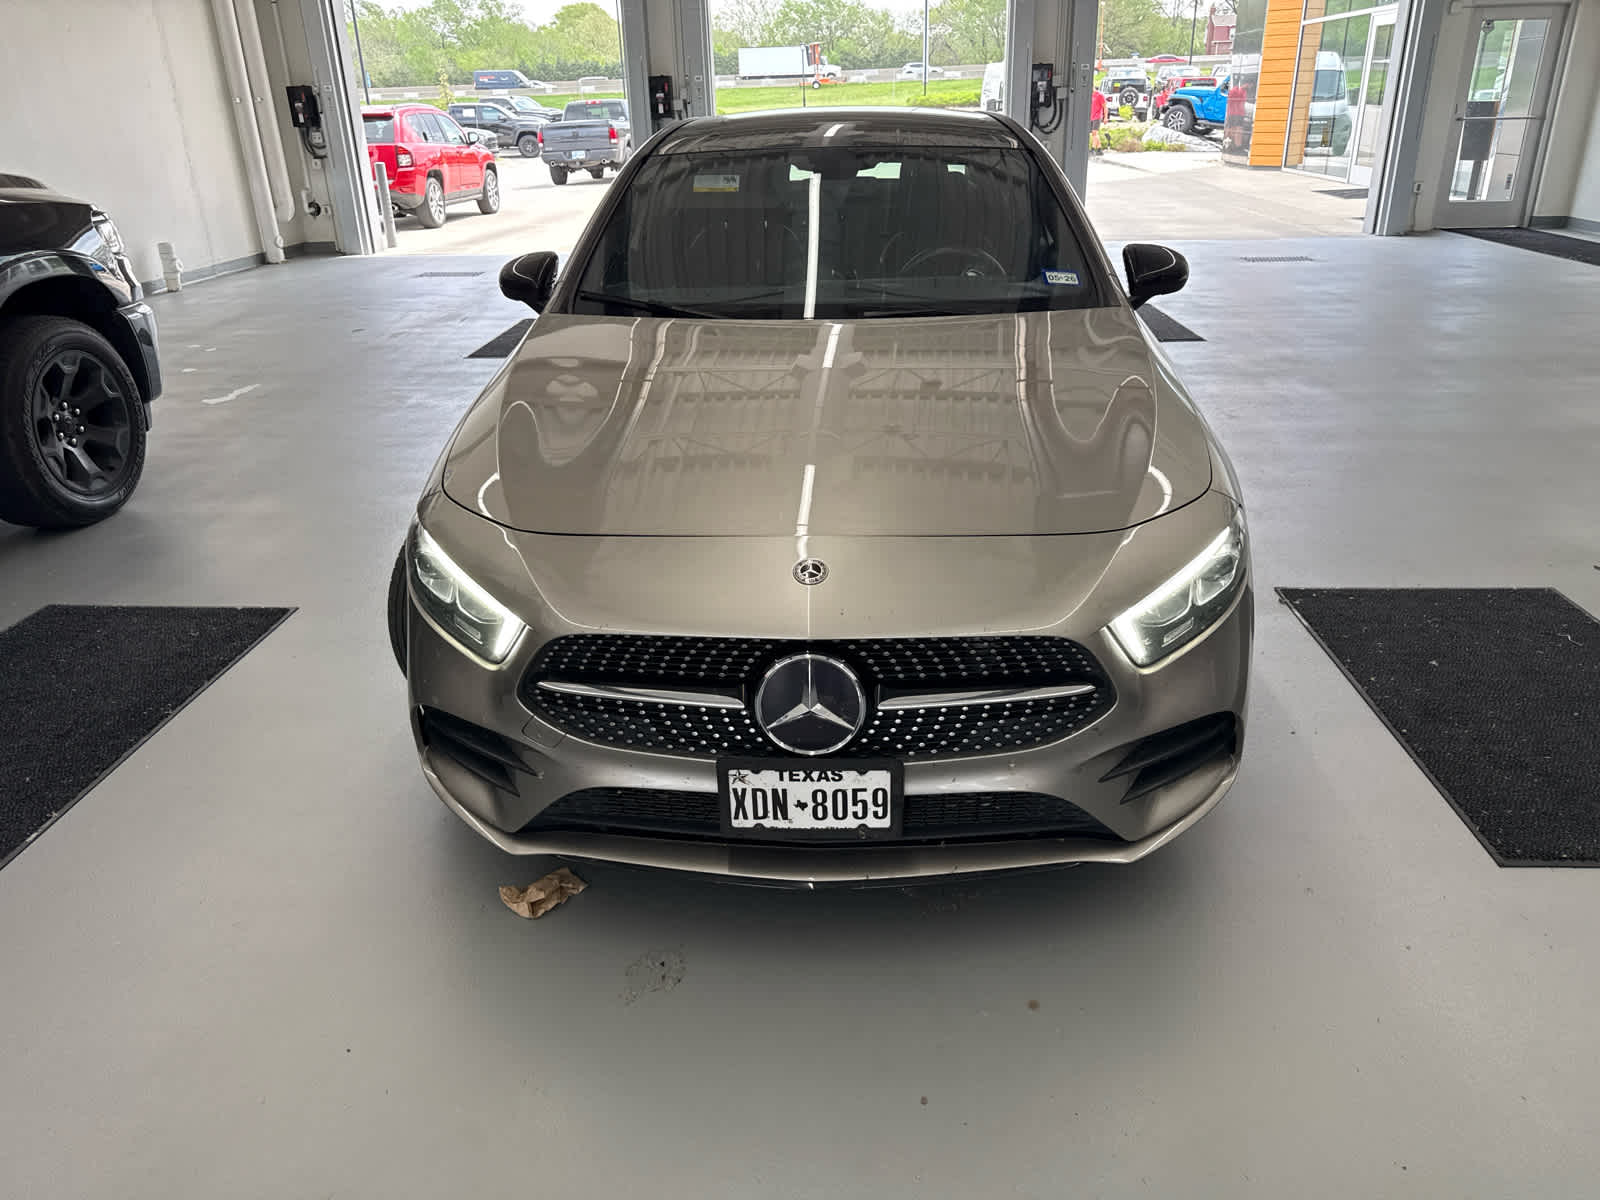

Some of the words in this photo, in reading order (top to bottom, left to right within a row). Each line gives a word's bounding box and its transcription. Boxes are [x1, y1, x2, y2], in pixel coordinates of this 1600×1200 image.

[777, 769, 844, 783] TEXAS
[731, 787, 789, 821] XDN
[811, 787, 889, 821] 8059
